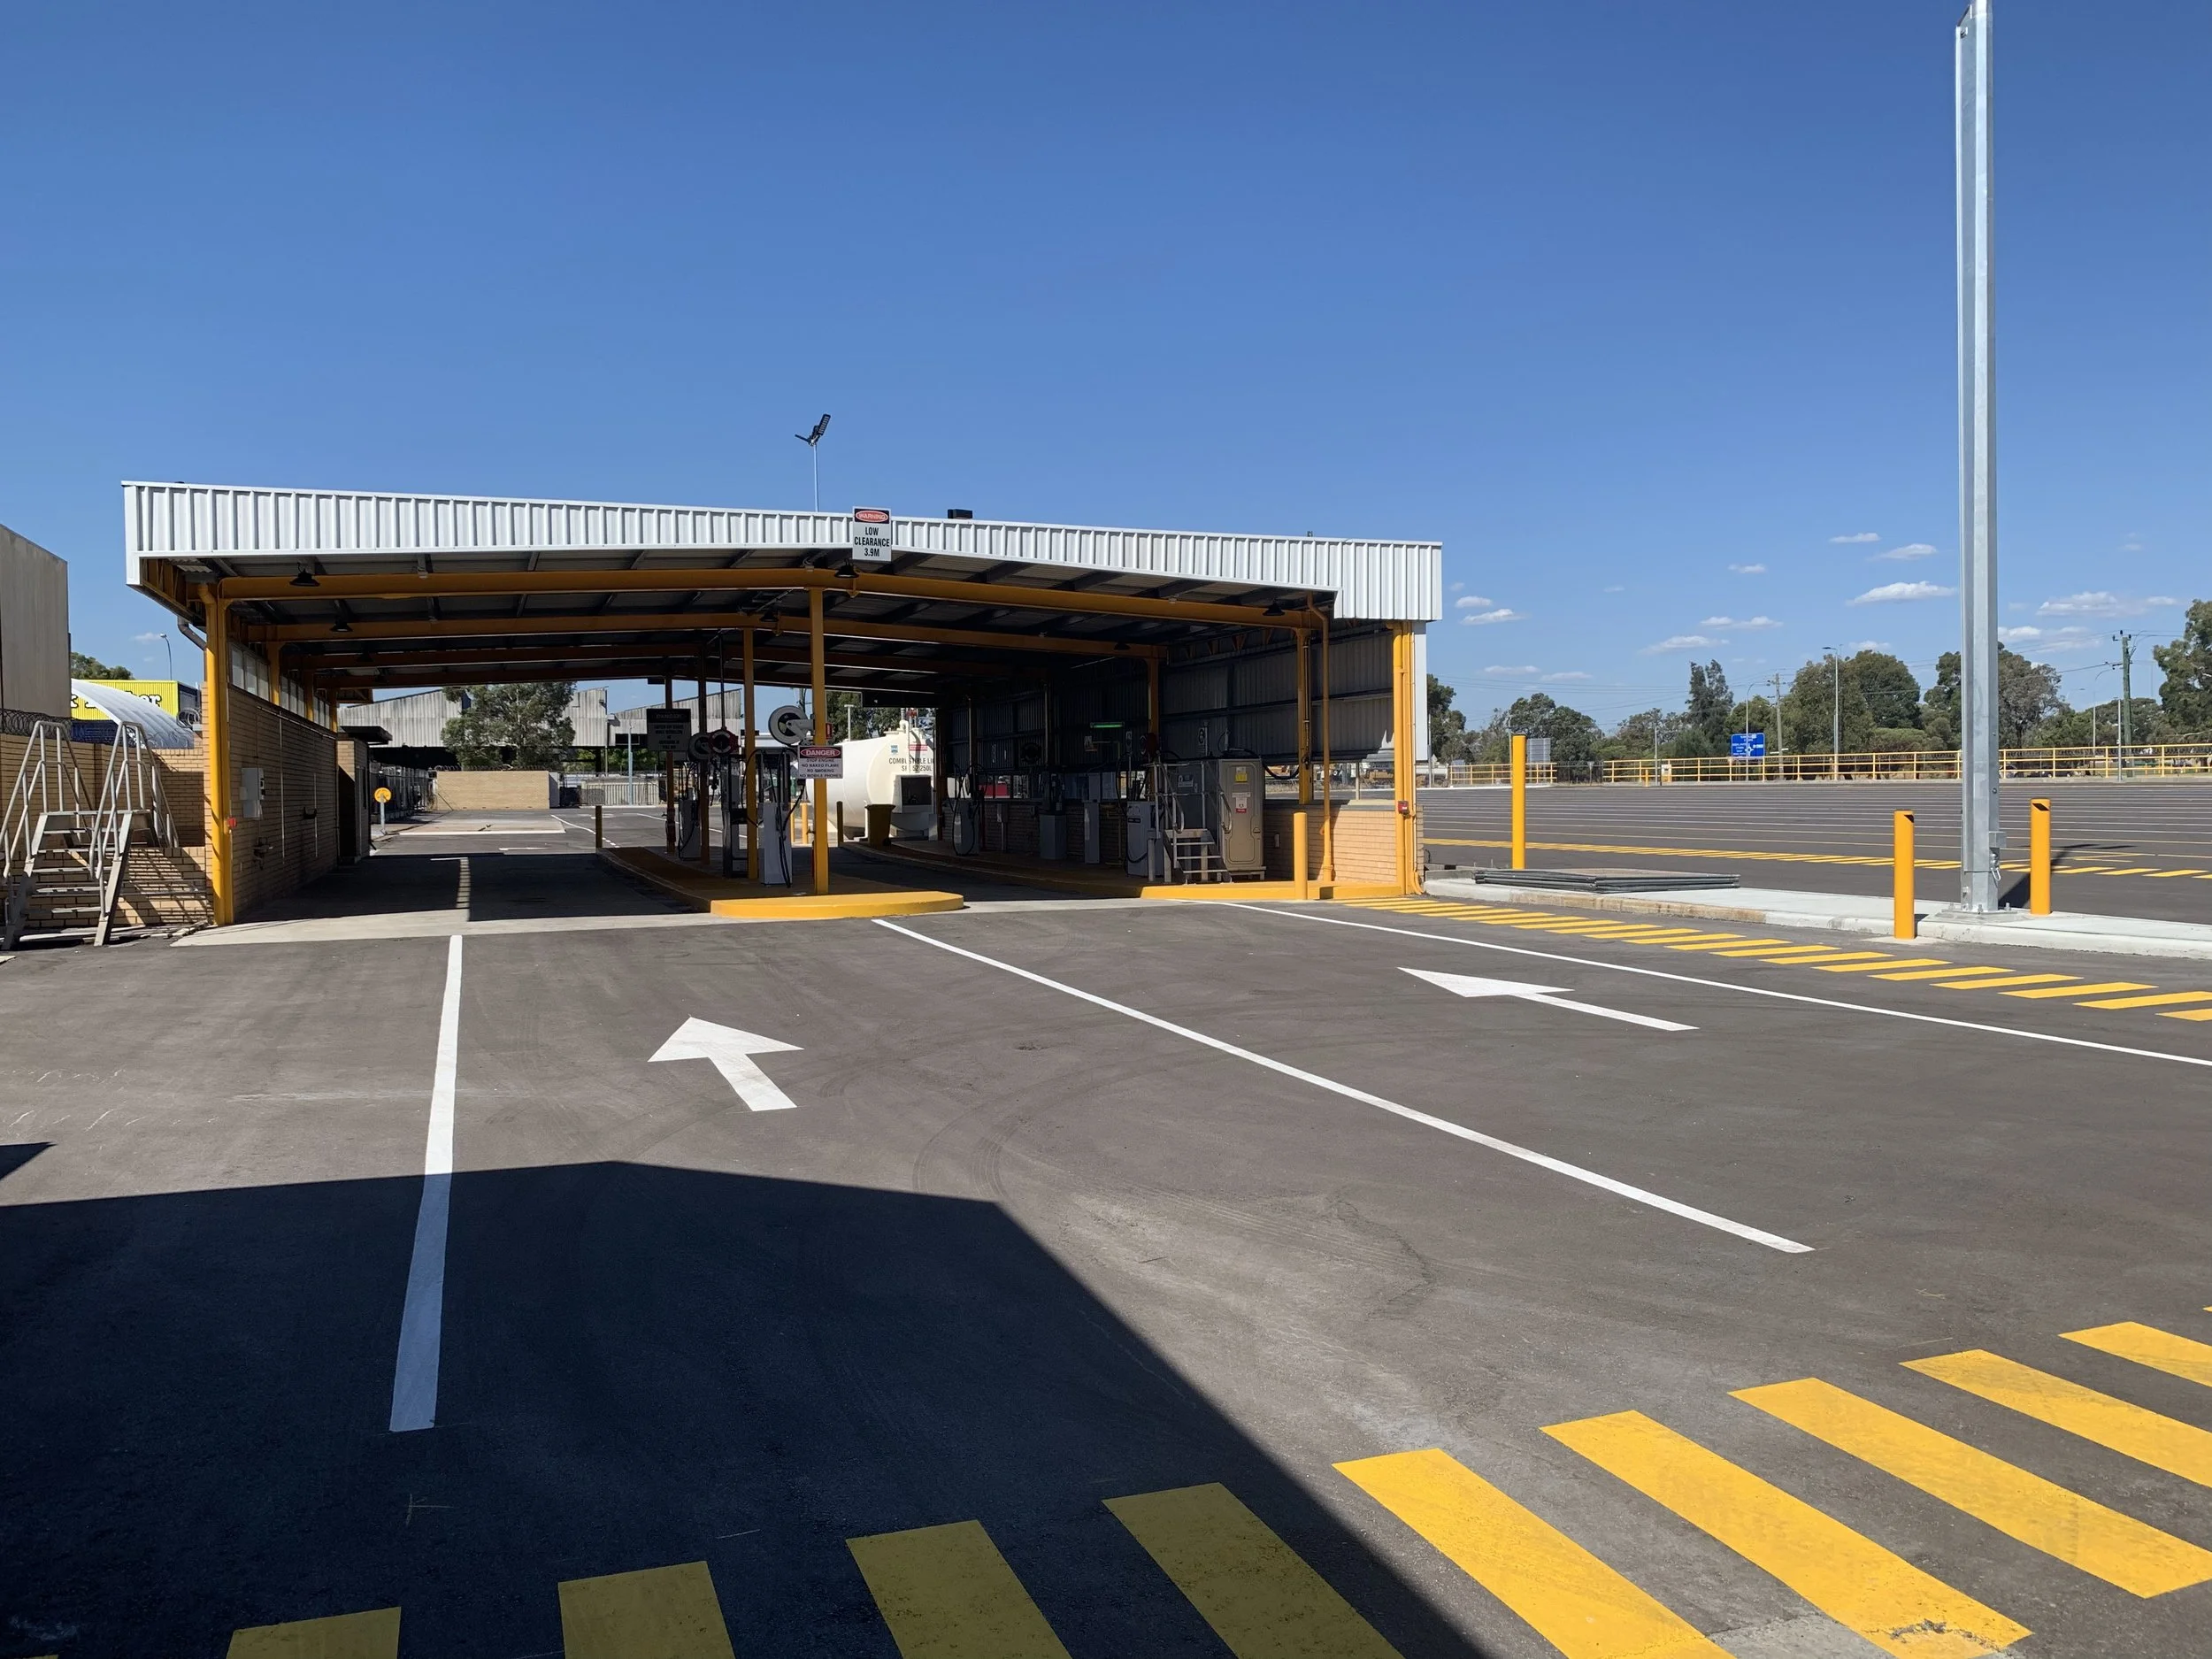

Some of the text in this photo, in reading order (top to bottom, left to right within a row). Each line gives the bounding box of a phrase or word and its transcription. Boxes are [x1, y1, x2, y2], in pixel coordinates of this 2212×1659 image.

[865, 526, 879, 535] LOW
[854, 537, 890, 547] CLEARANCE
[864, 548, 880, 557] 3.9M
